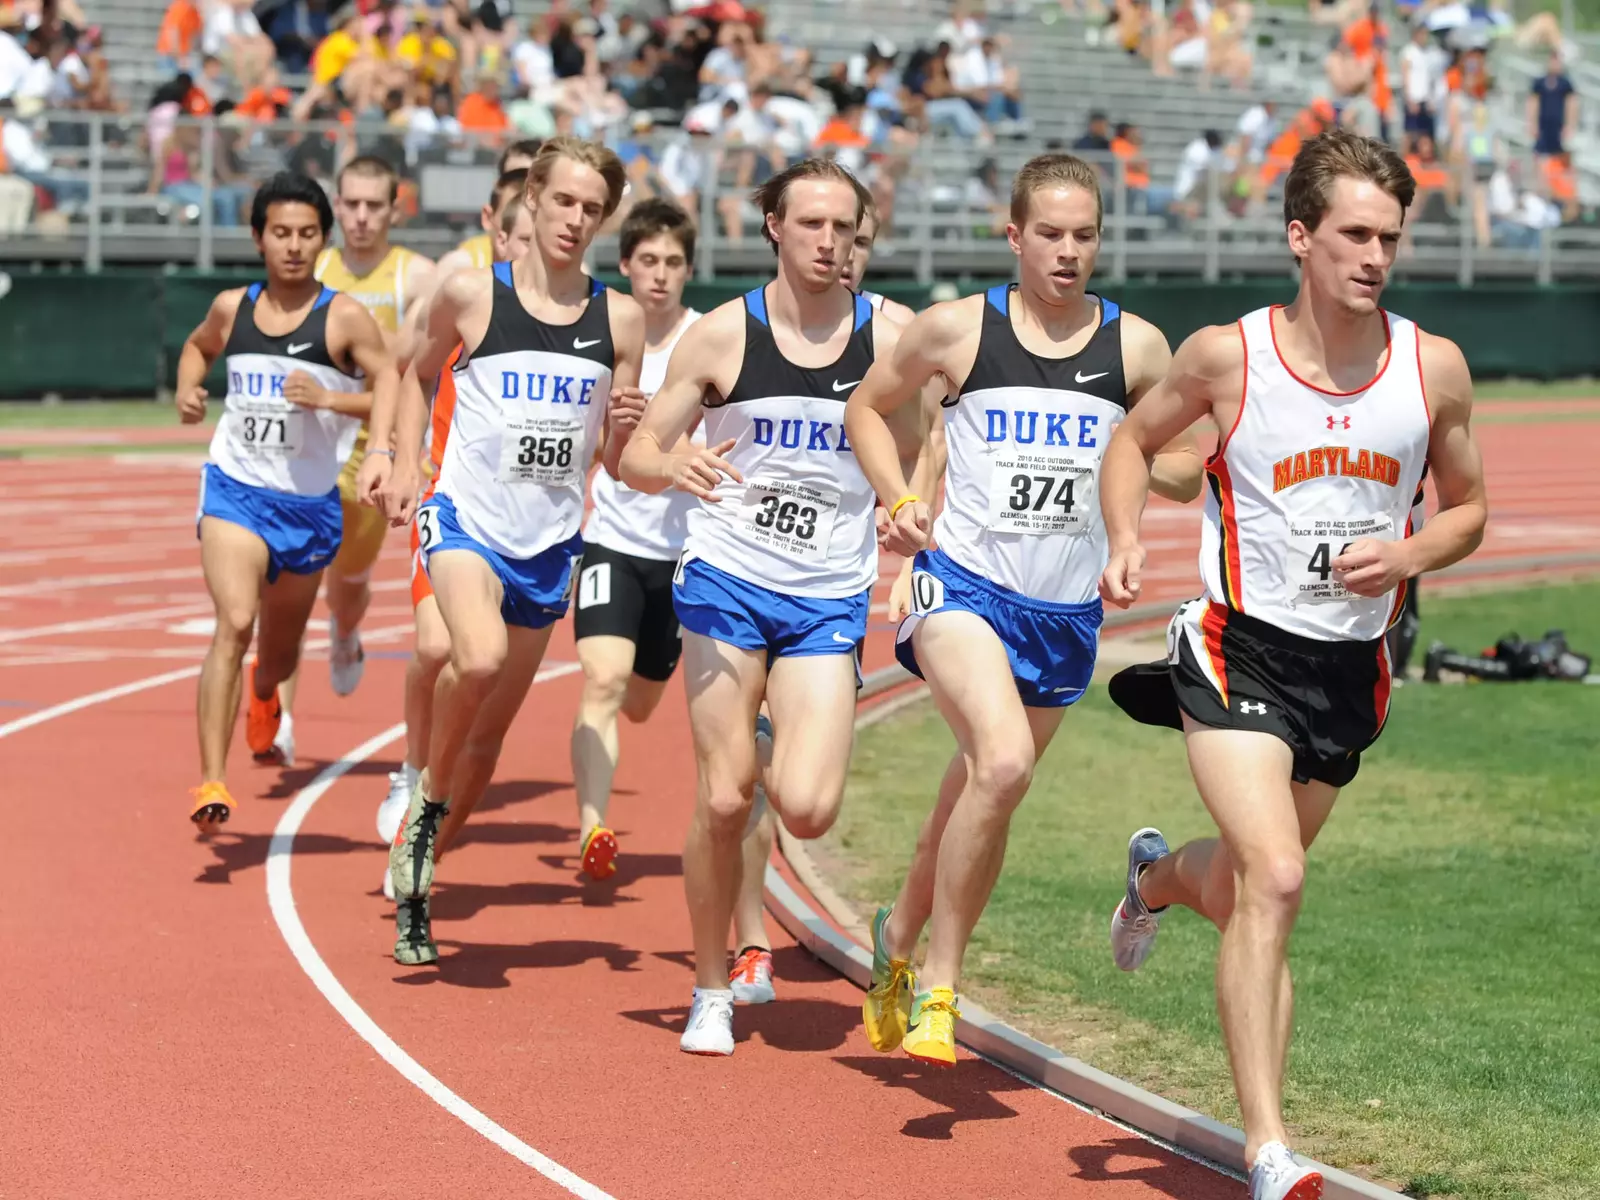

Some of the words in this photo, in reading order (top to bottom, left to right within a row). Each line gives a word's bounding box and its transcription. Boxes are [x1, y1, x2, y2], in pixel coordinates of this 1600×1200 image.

[232, 372, 285, 398] DUK
[501, 371, 597, 406] DUKE
[244, 416, 285, 443] 371
[985, 409, 1098, 448] DUKE
[518, 436, 572, 468] 358
[1048, 464, 1092, 474] CHAMPIONSHIPS
[1272, 446, 1401, 494] MARYLAND
[750, 484, 768, 492] TRACK
[797, 492, 837, 508] CHAMPIONSHIPS
[798, 485, 822, 497] OUTDOOR
[1009, 474, 1075, 514] 374
[755, 496, 818, 540] 363
[1000, 512, 1030, 520] CLEMSON,
[1348, 519, 1376, 528] OUTDOOR
[1350, 522, 1392, 537] CHAMPIONSHIPS
[773, 534, 790, 543] SOUTH
[792, 538, 818, 552] CAROLINA
[790, 545, 804, 554] 2010
[588, 570, 598, 600] 1
